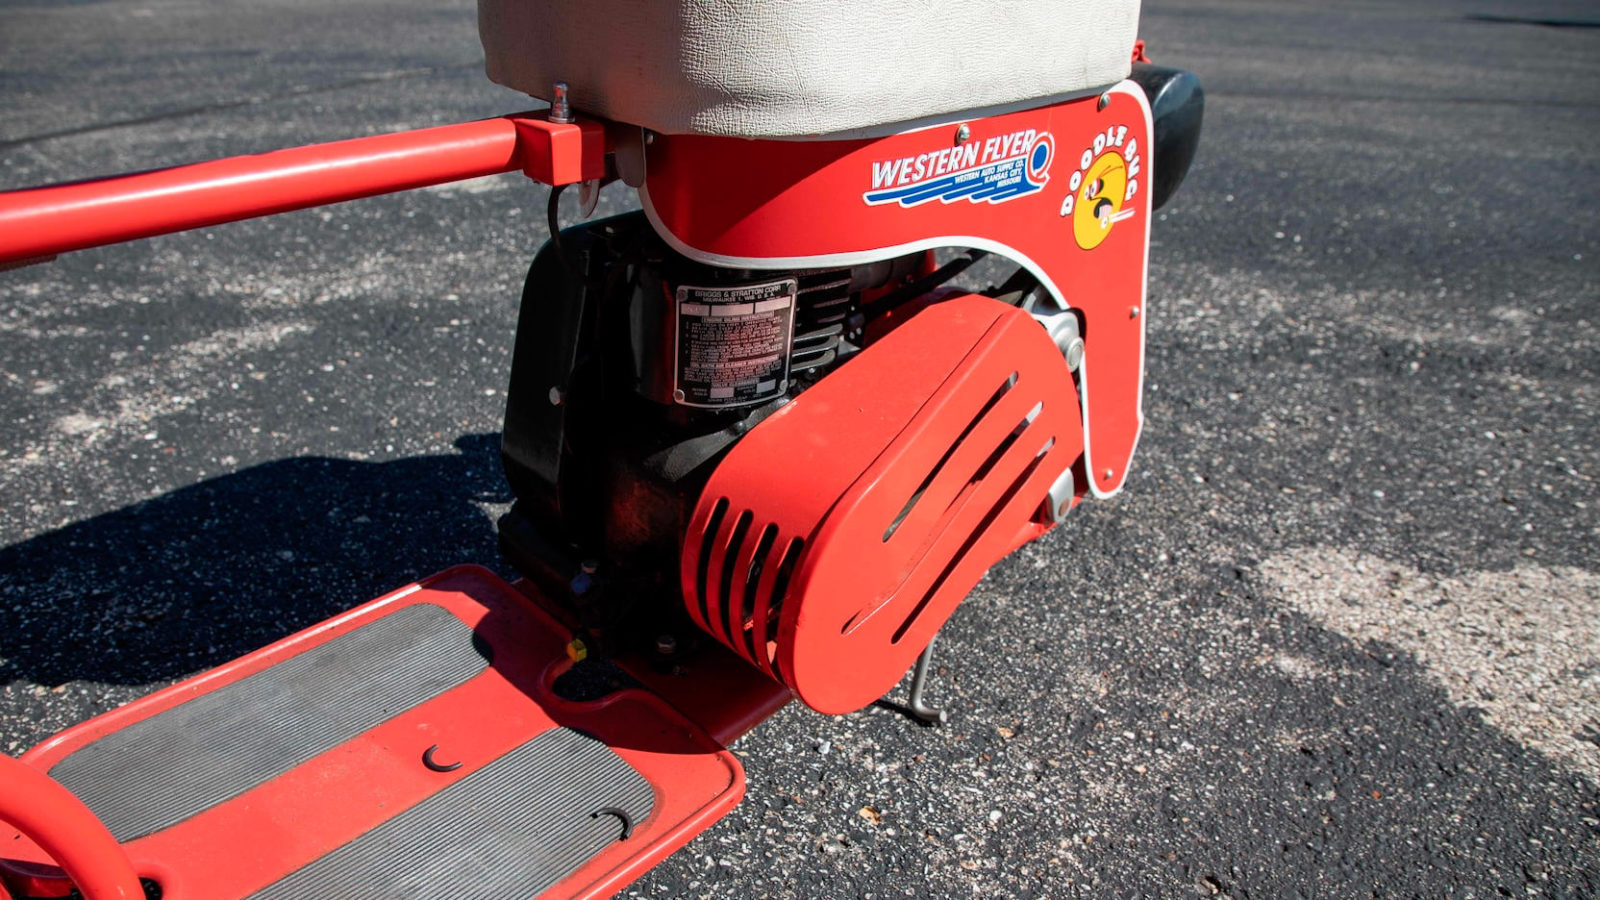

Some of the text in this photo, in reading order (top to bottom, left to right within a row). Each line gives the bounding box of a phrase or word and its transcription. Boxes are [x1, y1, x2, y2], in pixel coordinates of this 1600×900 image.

[872, 129, 1037, 189] WESTERN FLYER
[954, 172, 980, 184] WESTERN
[981, 167, 995, 178] AUTO
[996, 162, 1014, 174] SUPPLY
[984, 173, 1008, 184] KANSAS
[1060, 124, 1140, 217] DOODLE BUG
[695, 290, 722, 298] BRIGGS
[730, 288, 764, 298] STRATTON
